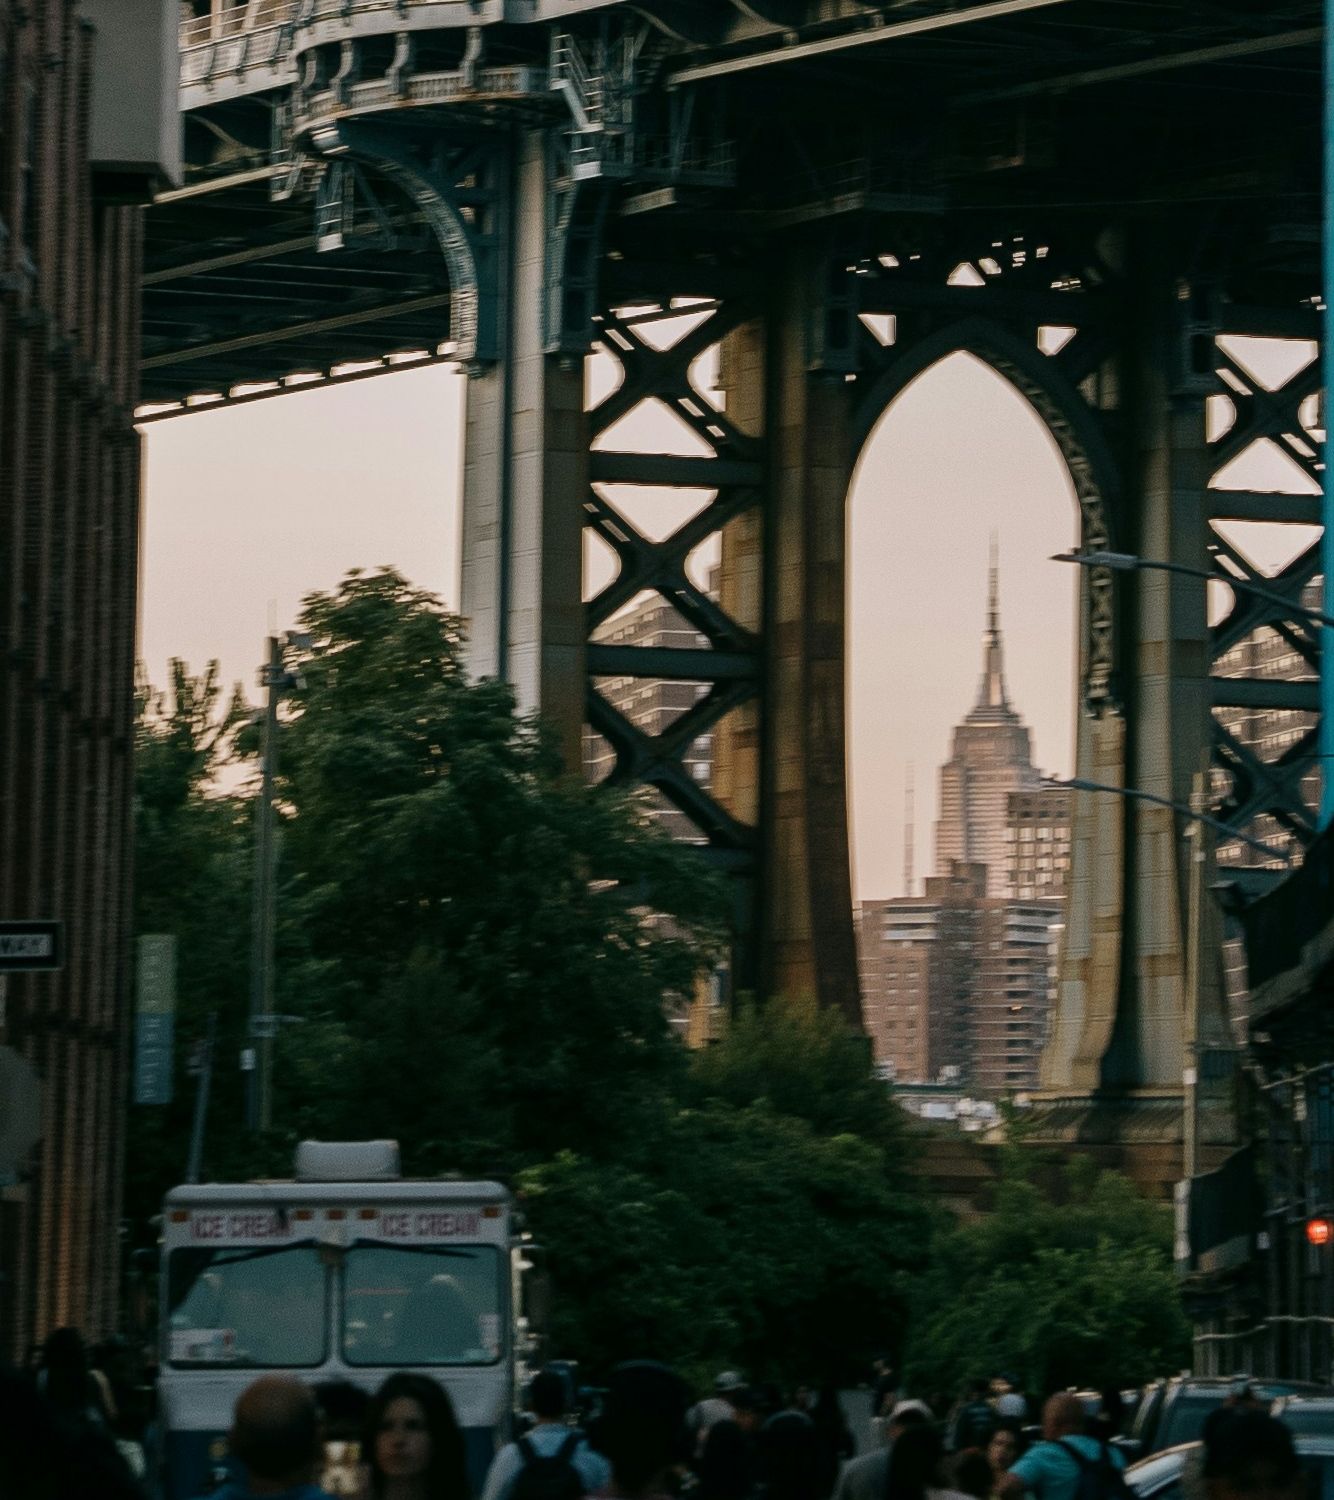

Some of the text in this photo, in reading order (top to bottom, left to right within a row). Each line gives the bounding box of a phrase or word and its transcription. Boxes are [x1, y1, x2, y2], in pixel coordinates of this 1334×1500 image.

[192, 1215, 294, 1238] ICE CREAM
[380, 1213, 480, 1237] ICE CREAM
